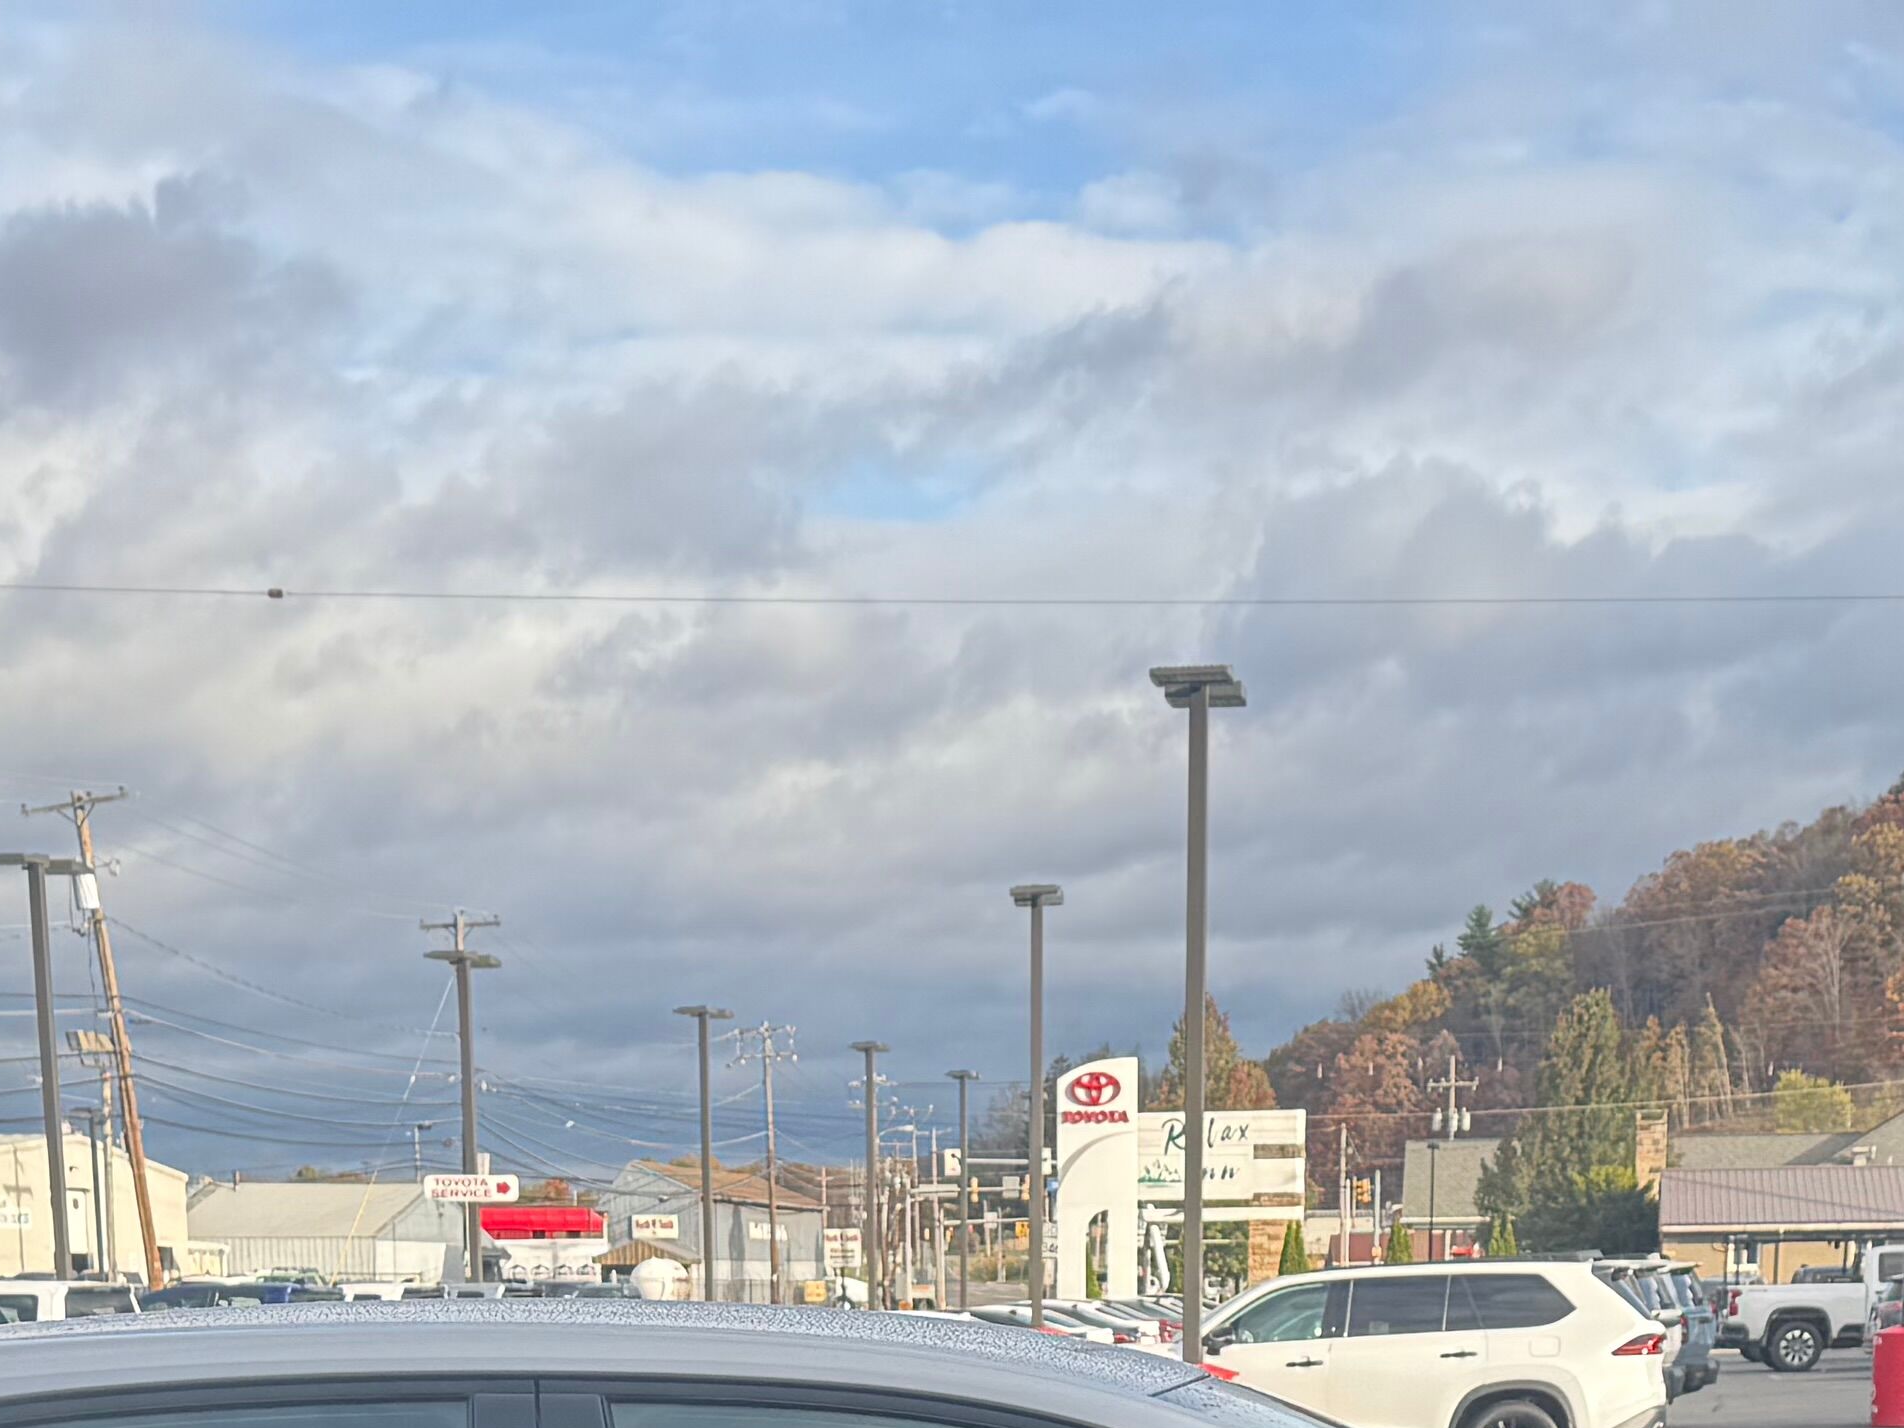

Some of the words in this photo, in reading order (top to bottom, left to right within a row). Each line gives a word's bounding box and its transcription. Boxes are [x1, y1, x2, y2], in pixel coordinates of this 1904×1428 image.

[1061, 1110, 1129, 1124] TOYOTA
[1161, 1117, 1249, 1156] Rlax
[435, 1178, 488, 1187] TOYOTA
[431, 1189, 492, 1198] SERVICE
